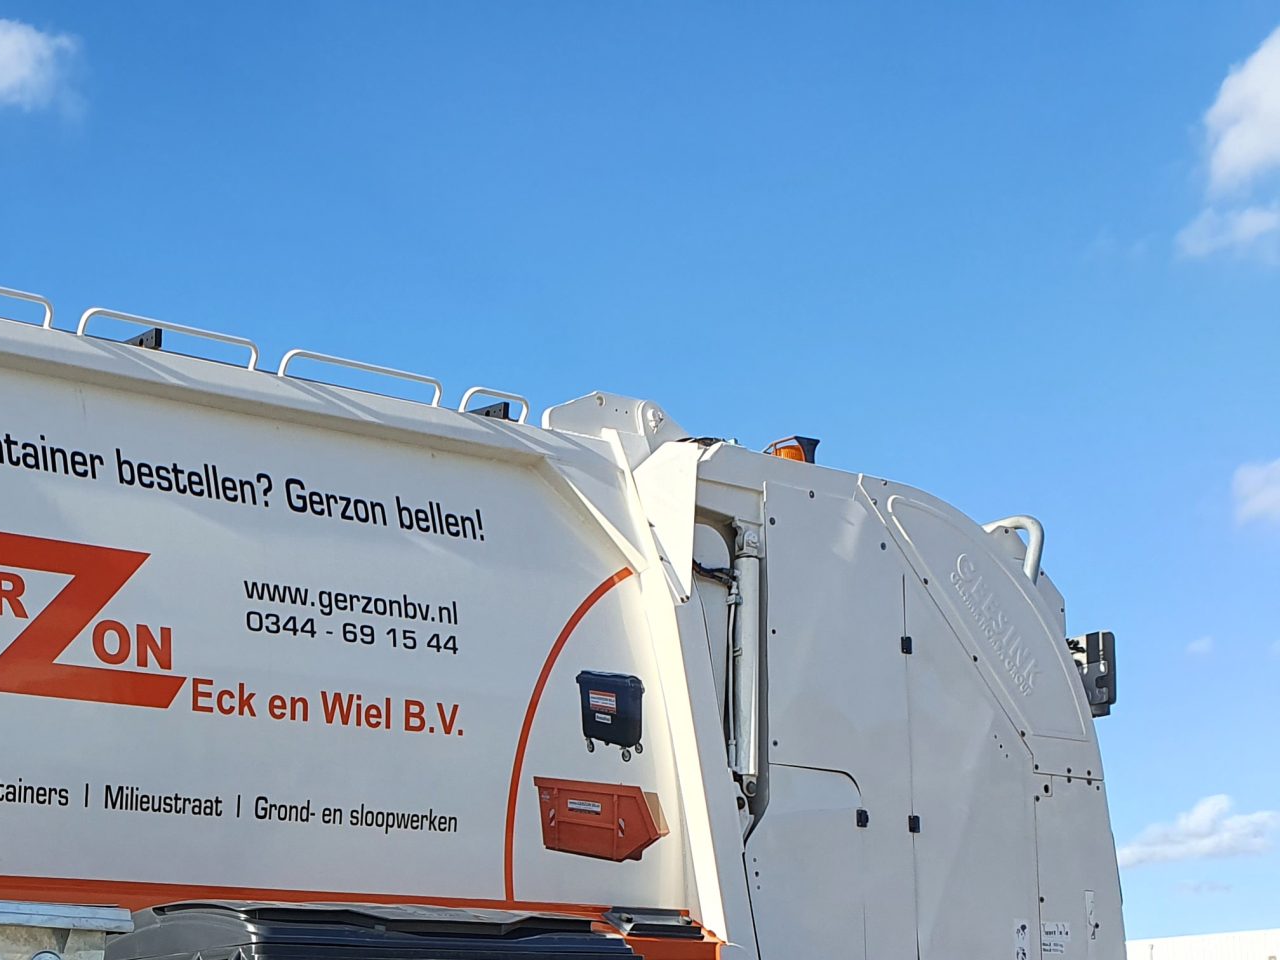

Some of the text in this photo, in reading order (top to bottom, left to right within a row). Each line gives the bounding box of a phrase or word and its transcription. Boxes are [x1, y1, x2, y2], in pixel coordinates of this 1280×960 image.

[115, 448, 273, 508] bestellen?
[285, 478, 388, 526] Gerzon
[395, 495, 485, 541] bellen!
[243, 580, 459, 625] www.gerzonbv.nl
[246, 611, 317, 639] 0344
[342, 622, 376, 645] 69
[385, 628, 417, 650] 15
[426, 633, 459, 655] 44
[191, 677, 464, 736] Eck en Wiel B.V.
[104, 784, 223, 816] Milieustraat
[254, 795, 316, 822] Grond-
[322, 805, 343, 825] en
[349, 803, 458, 834] sloopwerken
